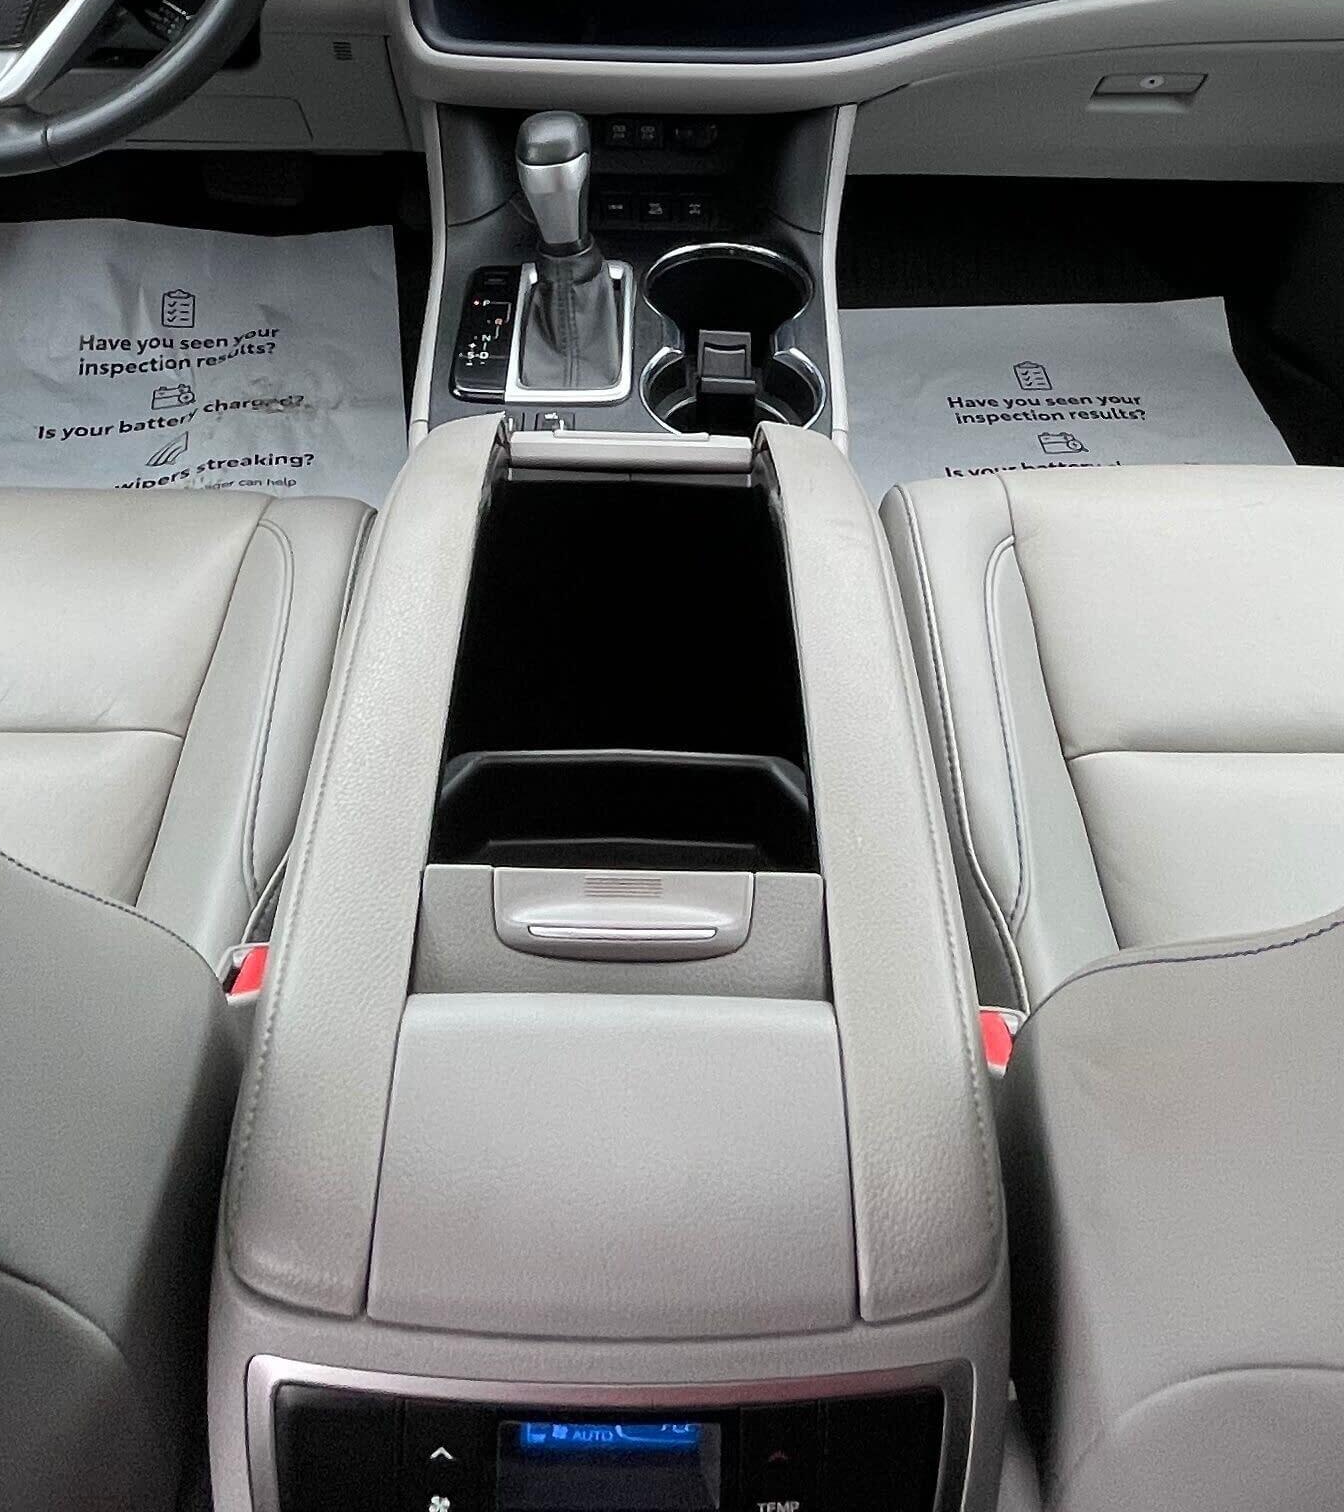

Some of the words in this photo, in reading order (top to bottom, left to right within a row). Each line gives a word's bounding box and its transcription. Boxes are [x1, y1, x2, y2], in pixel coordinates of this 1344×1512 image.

[78, 334, 132, 352] Have
[136, 337, 174, 355] you
[179, 338, 228, 350] seen
[233, 326, 280, 347] your
[481, 334, 492, 342] N
[78, 354, 192, 379] inspection
[195, 341, 276, 368] results?
[947, 395, 998, 409] Have
[1003, 397, 1041, 409] you
[1045, 395, 1093, 406] seen
[1095, 394, 1141, 406] your
[37, 425, 57, 440] Is
[60, 424, 115, 441] your
[118, 407, 199, 434] battery
[954, 409, 1065, 425] inspection
[1069, 407, 1146, 421] results?
[195, 452, 316, 474] streaking?
[238, 479, 262, 487] can
[266, 476, 297, 488] help
